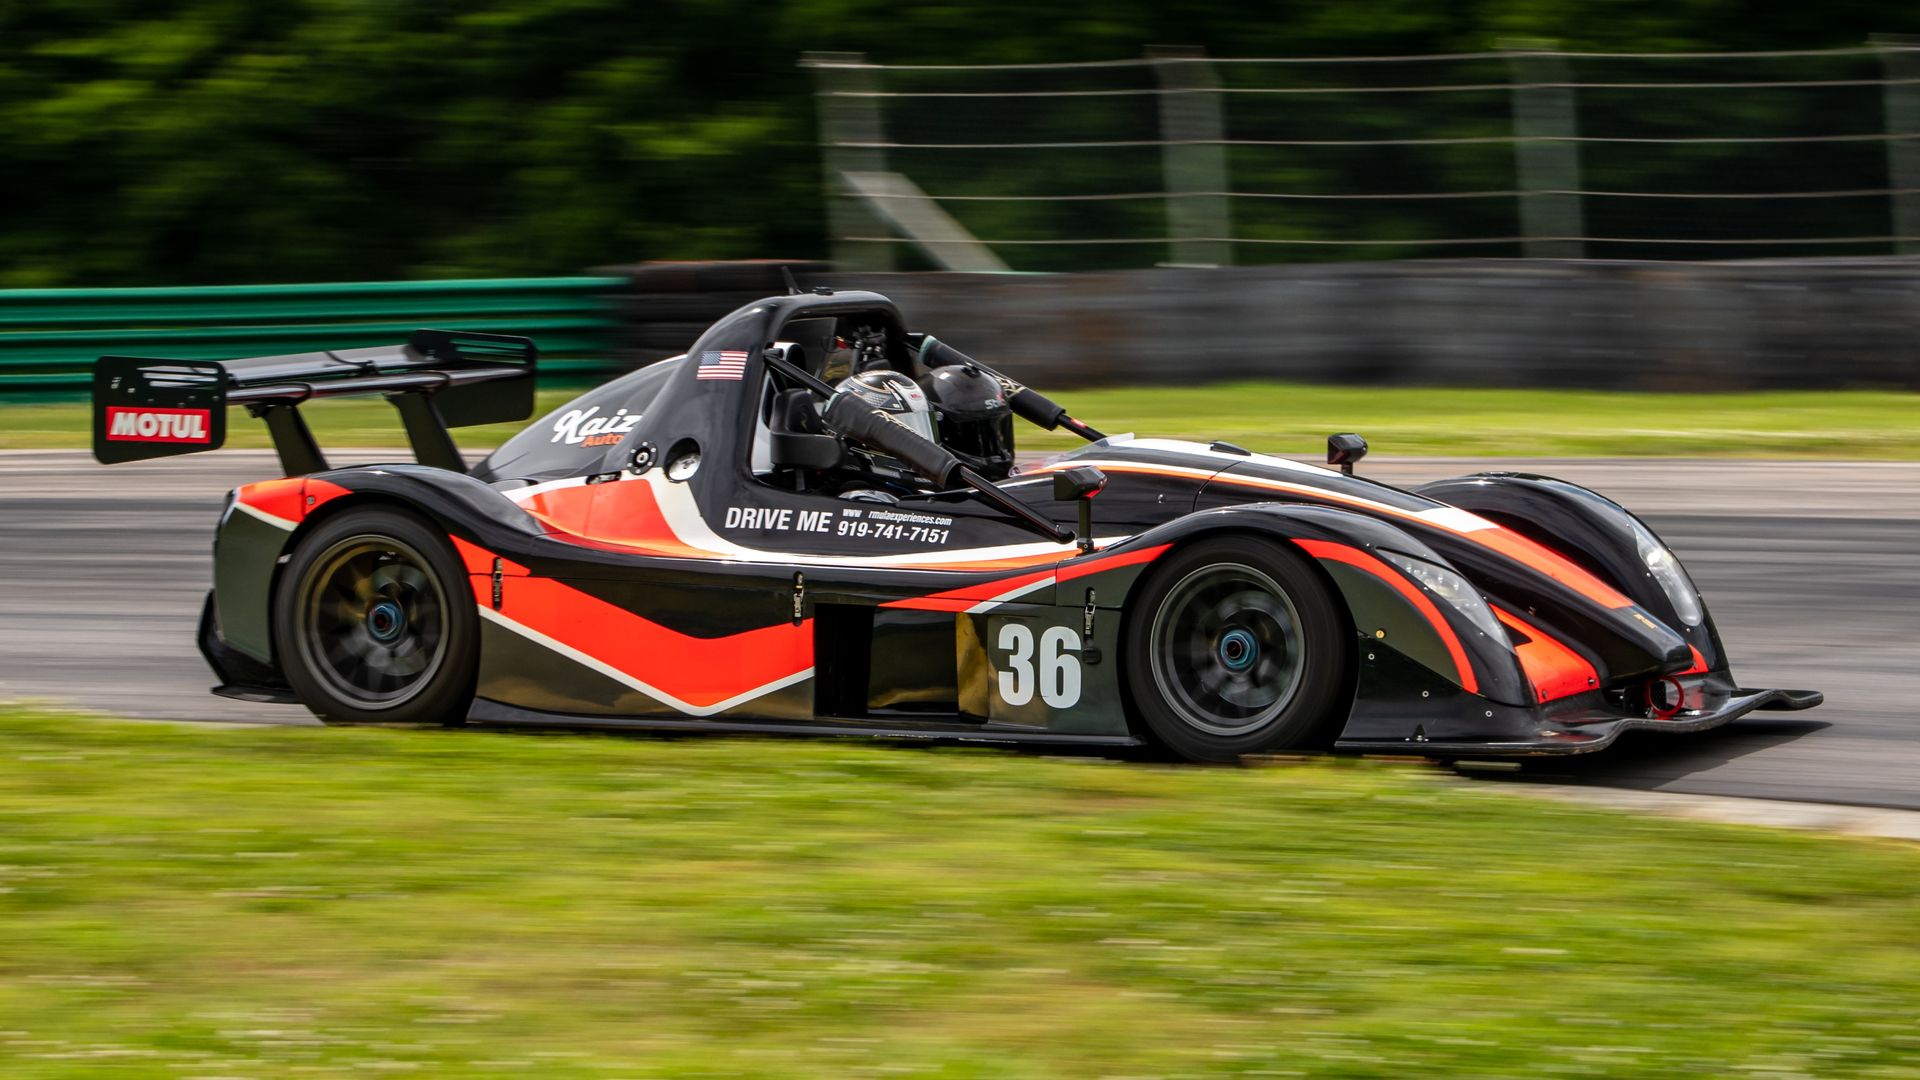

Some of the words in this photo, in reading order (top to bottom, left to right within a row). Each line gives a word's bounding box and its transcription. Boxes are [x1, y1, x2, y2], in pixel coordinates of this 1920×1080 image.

[109, 411, 207, 439] MOTUL
[724, 507, 793, 531] DRIVE
[796, 510, 833, 533] ME
[837, 520, 950, 545] 919-741-7151
[998, 623, 1082, 709] 36
